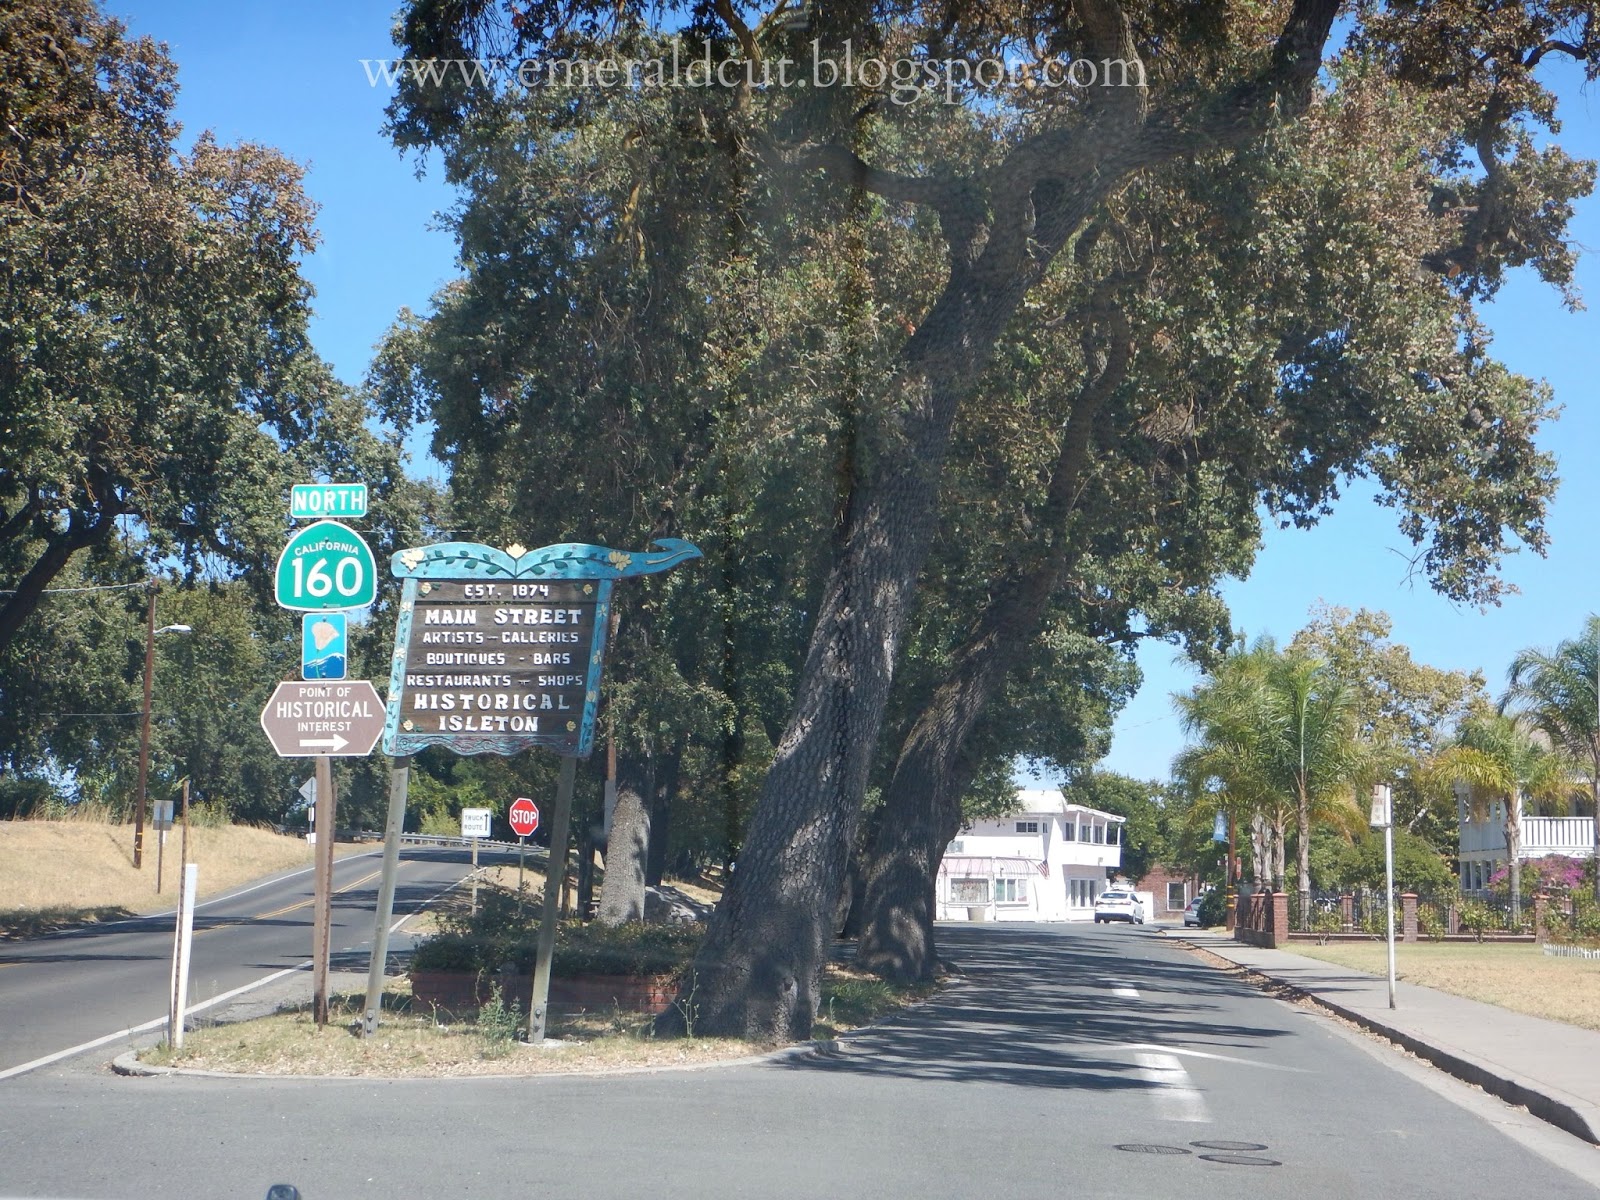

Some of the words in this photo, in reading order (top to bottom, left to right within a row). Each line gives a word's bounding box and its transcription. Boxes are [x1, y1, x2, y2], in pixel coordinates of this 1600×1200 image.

[294, 490, 364, 511] NORTH
[294, 541, 359, 556] CALIFORNIA
[291, 556, 364, 598] 160
[464, 584, 502, 597] EST.
[512, 584, 549, 597] 1874
[424, 609, 477, 625] MAIN
[494, 608, 582, 625] STREET
[422, 631, 484, 644] ARTISTS
[426, 653, 505, 665] BOUTIQUES
[533, 653, 571, 665] BARS
[407, 674, 511, 687] RESTAURANTS
[538, 675, 583, 686] SHOPS
[299, 687, 332, 698] POINT
[336, 687, 352, 697] OF
[413, 693, 570, 711] HISTORICAL
[276, 701, 373, 719] HISTORICAL
[297, 721, 352, 733] INTEREST
[438, 715, 539, 732] ISLETON
[464, 814, 483, 822] TRUCK
[512, 809, 537, 824] STOP
